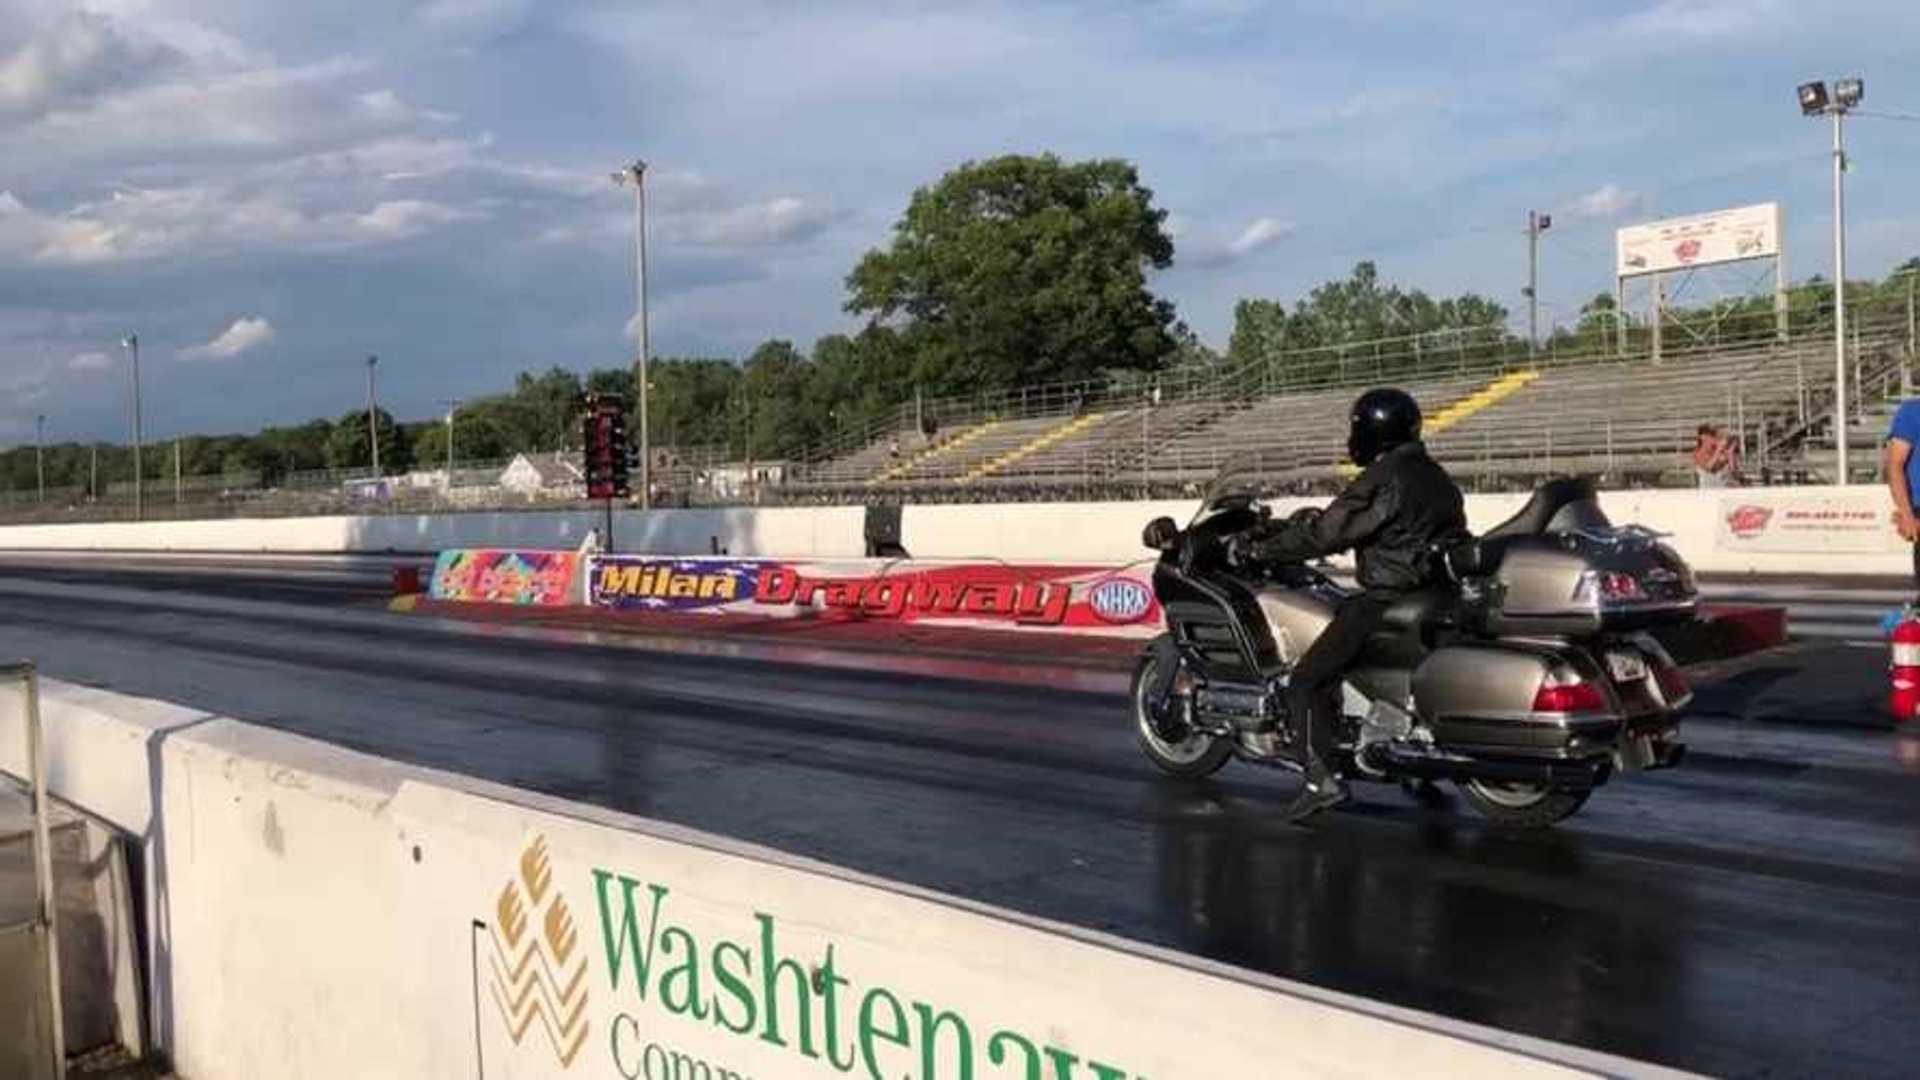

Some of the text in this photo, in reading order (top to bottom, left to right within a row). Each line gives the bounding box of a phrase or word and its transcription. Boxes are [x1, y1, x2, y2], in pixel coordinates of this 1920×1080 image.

[600, 564, 737, 600] Milan
[755, 567, 1073, 625] Dragway
[1094, 580, 1149, 619] NHRA
